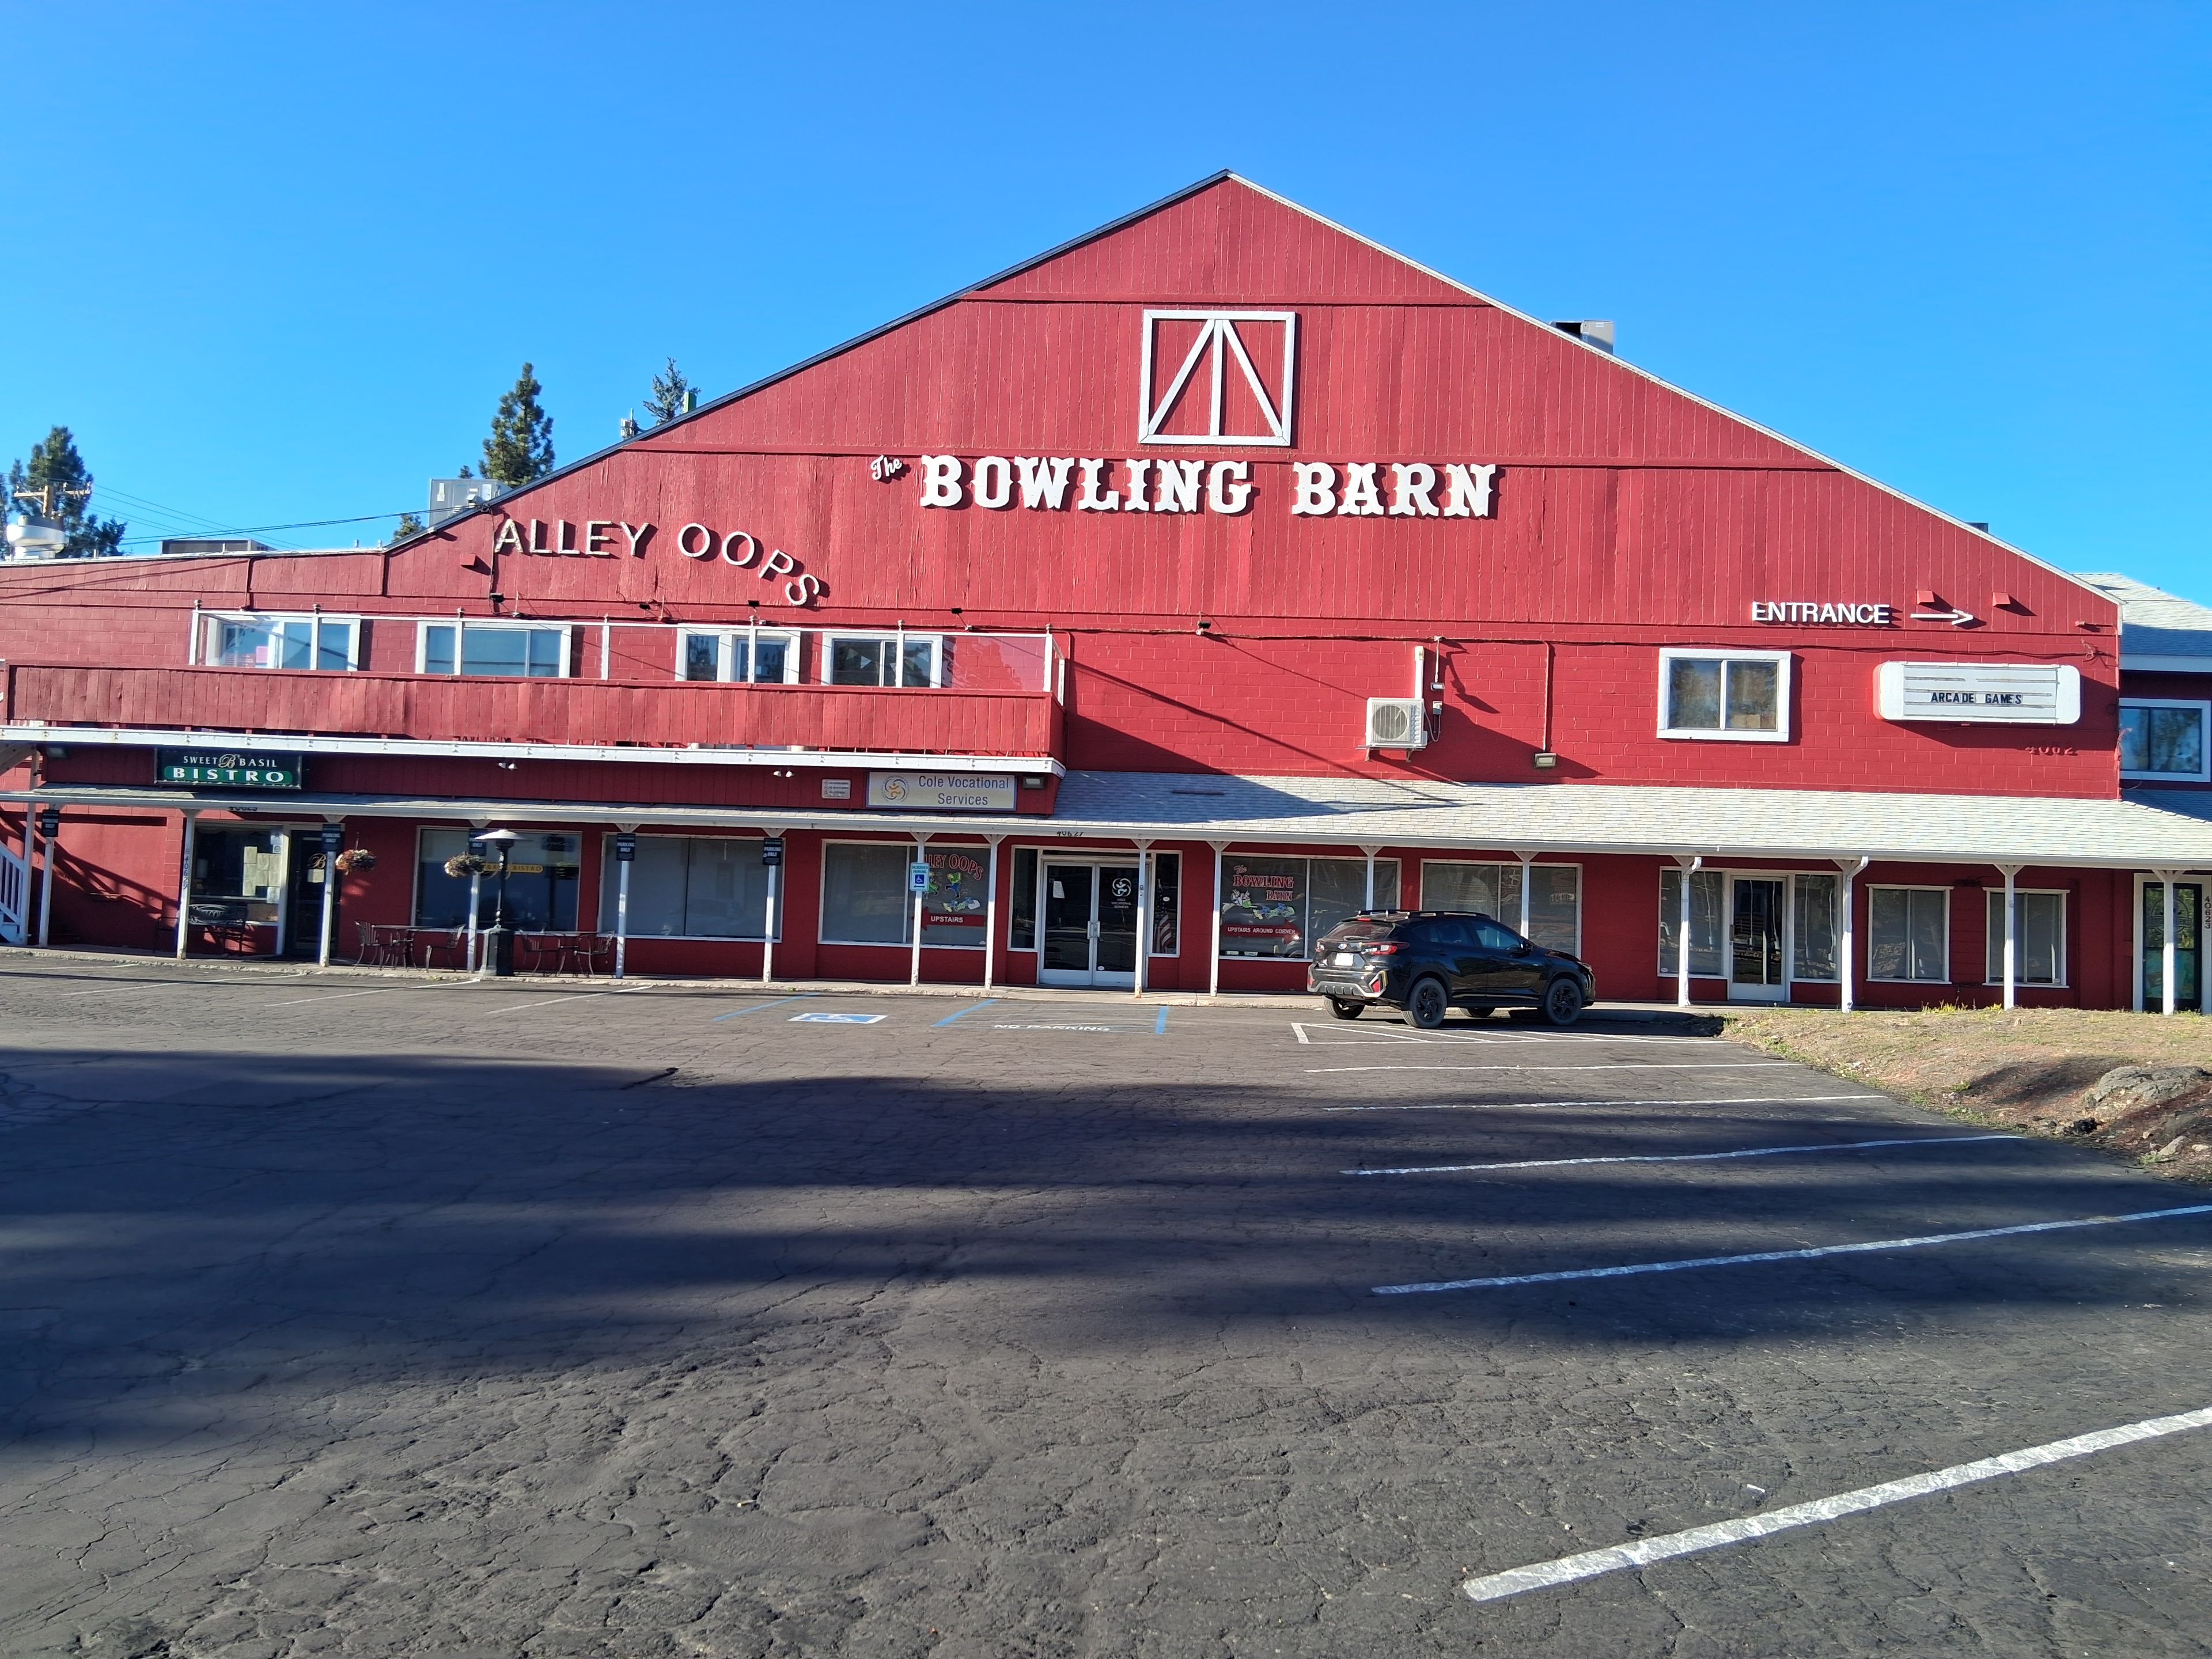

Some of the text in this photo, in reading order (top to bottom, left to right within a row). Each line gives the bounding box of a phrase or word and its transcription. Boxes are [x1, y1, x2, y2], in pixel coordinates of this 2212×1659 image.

[870, 454, 903, 480] The
[920, 454, 1497, 518] BOWLING BARN
[494, 518, 820, 605] ALLEY OOPS
[1751, 601, 1890, 624] ENTRANCE
[1931, 692, 2022, 704] ARCADE GAMES
[183, 755, 218, 765] SWEET
[240, 759, 278, 768] BASIL
[173, 767, 284, 783] BISTRO
[918, 775, 1009, 790] Cole Vocational
[938, 793, 988, 805] Services
[949, 854, 984, 880] OOPS
[1233, 865, 1247, 874] The
[1233, 874, 1294, 888] BOWLING
[1266, 890, 1293, 902] BARN
